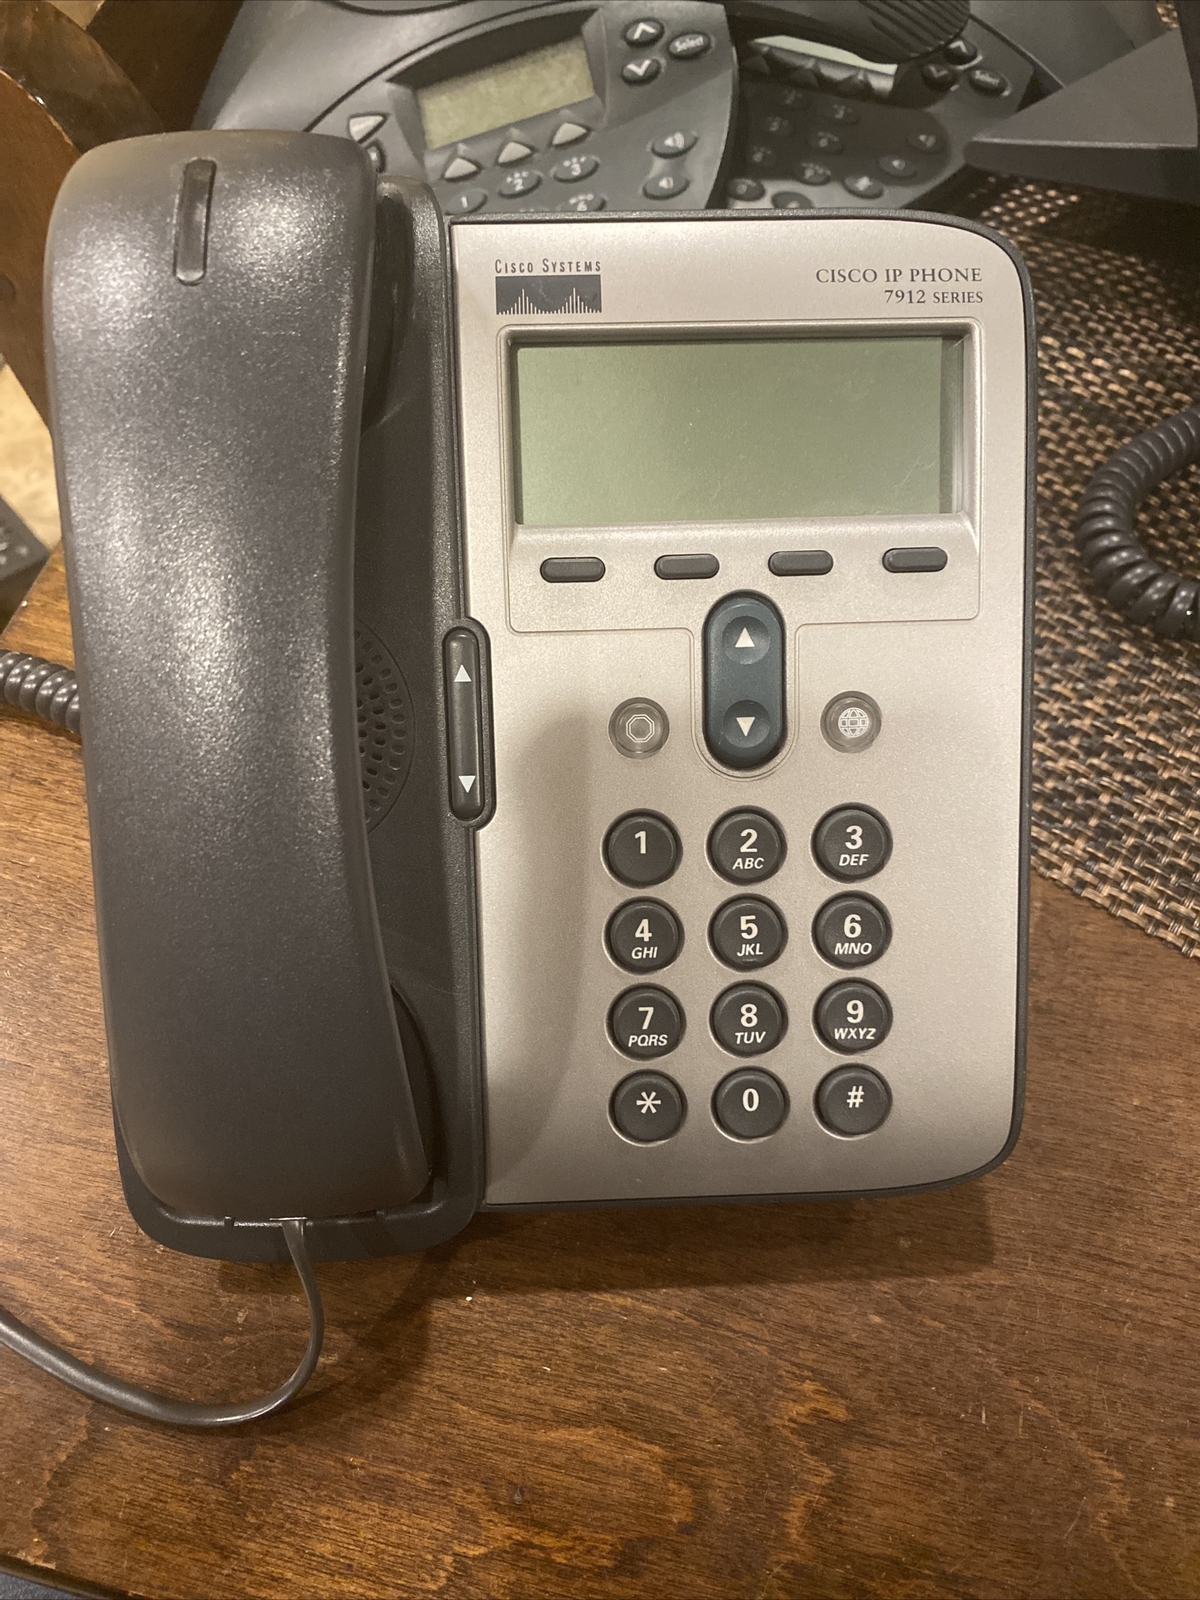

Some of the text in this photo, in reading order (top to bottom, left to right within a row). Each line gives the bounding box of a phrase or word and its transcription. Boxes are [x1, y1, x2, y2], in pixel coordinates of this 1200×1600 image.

[494, 258, 602, 274] CISCO SYSTEMS
[815, 267, 983, 283] CISCO IP PHONE
[884, 289, 984, 304] 7912 SERIES
[634, 830, 648, 855] 1
[739, 828, 759, 853] 2
[844, 825, 864, 851] 3
[731, 857, 765, 871] ABC
[838, 853, 870, 867] DEF
[634, 918, 653, 943] 4
[740, 914, 759, 940] 5
[843, 913, 863, 939] 6
[630, 946, 659, 960] GHI
[736, 942, 764, 957] JKL
[833, 942, 873, 956] MNO
[637, 1006, 655, 1031] 7
[739, 1003, 759, 1028] 8
[845, 999, 865, 1024] 9
[627, 1033, 669, 1048] PQRS
[734, 1031, 767, 1045] TUV
[833, 1027, 877, 1040] WXYZ
[741, 1087, 760, 1112] 0
[846, 1085, 865, 1109] #
